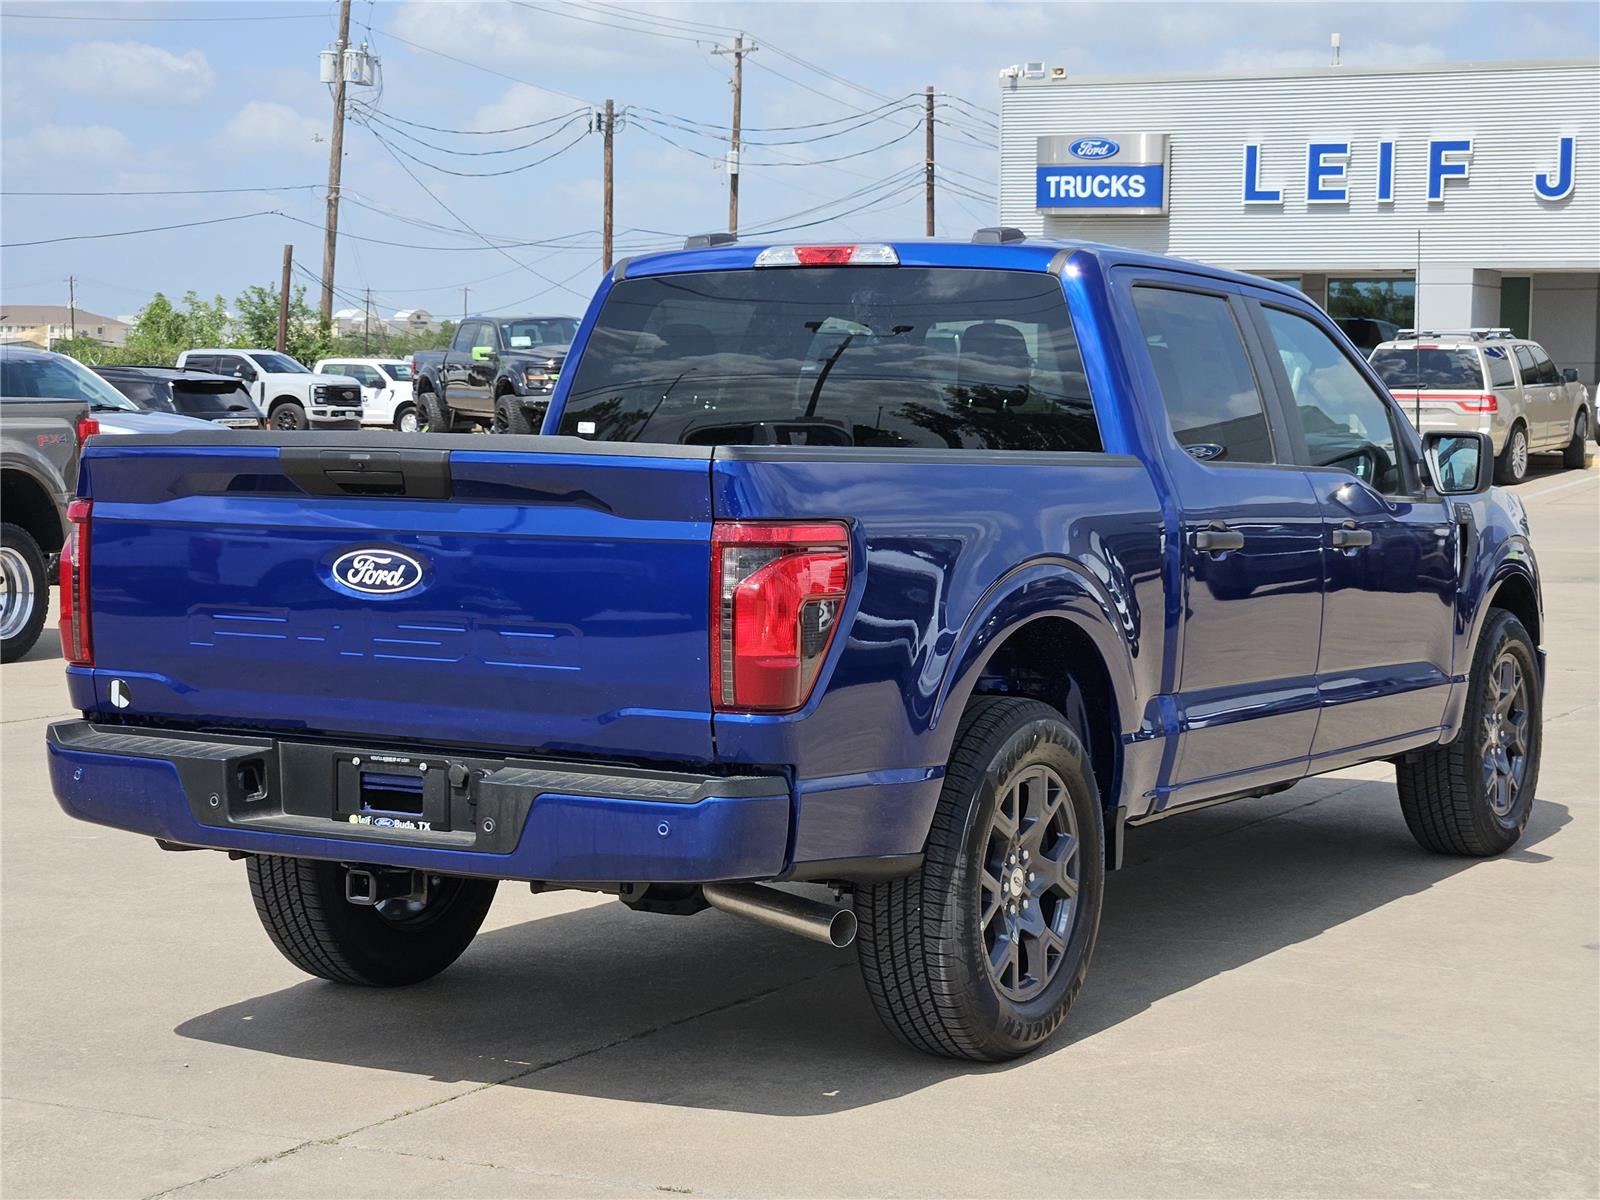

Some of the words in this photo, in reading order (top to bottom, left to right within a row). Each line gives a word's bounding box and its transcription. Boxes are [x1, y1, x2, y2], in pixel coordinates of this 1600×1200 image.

[1077, 140, 1110, 155] Ford
[1243, 139, 1474, 204] LEIF
[1533, 135, 1577, 201] J
[1045, 174, 1146, 198] TRUCKS
[37, 433, 67, 447] FX4
[346, 554, 405, 586] Ford
[418, 821, 431, 832] TX
